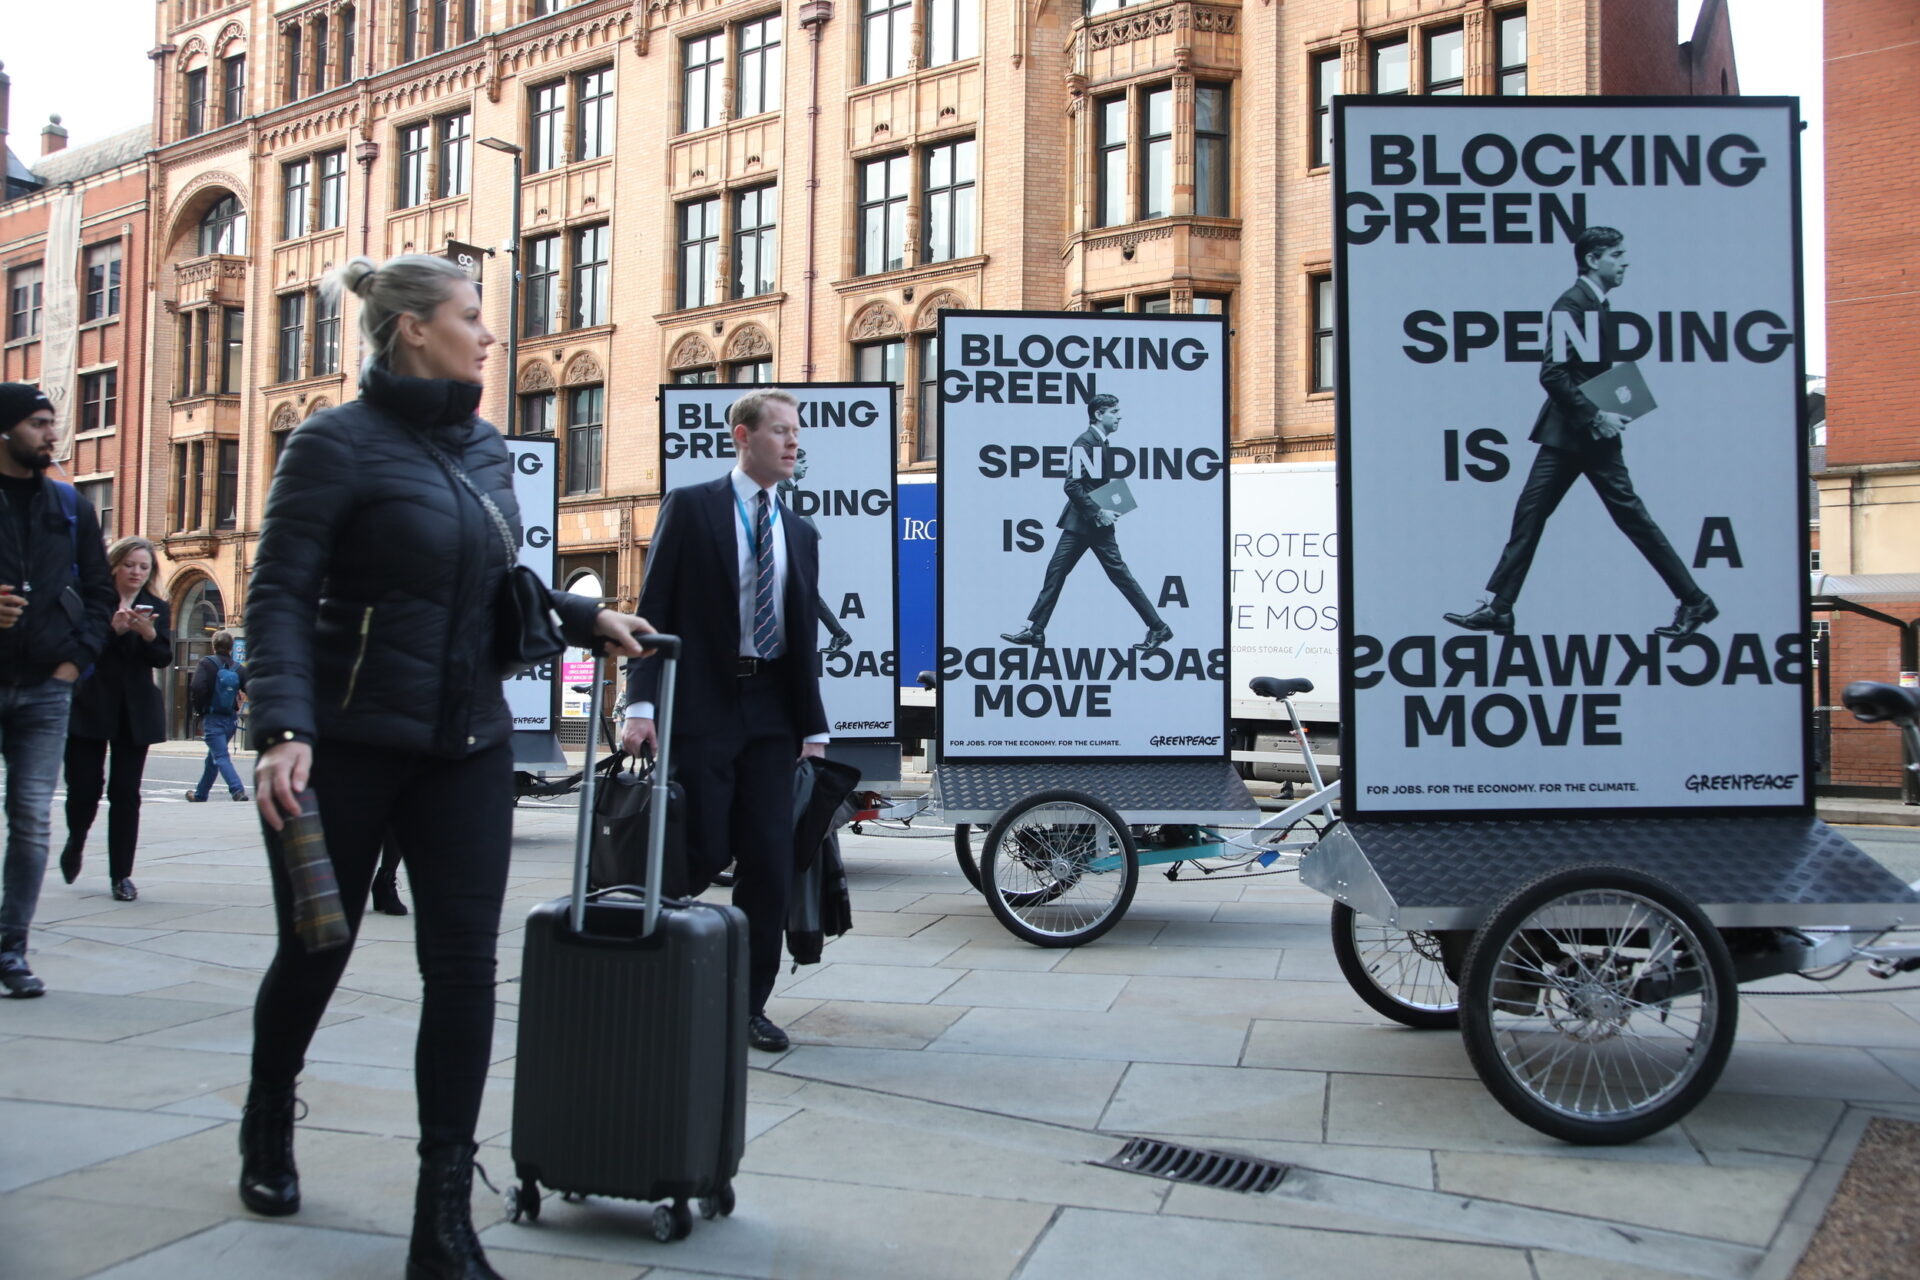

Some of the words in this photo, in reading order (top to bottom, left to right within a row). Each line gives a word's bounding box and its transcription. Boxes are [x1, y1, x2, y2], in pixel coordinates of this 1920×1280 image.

[1370, 133, 1767, 187] BLOCKING
[1347, 191, 1587, 245] GREEN
[961, 334, 1209, 371] BLOCKING
[1402, 309, 1794, 364] SPENDING
[944, 369, 1097, 405] GREEN
[678, 400, 880, 430] BLKING
[665, 432, 738, 460] GRE
[978, 444, 1224, 481] SPENDING
[1444, 428, 1511, 483] IS
[1002, 518, 1045, 553] IS
[1233, 532, 1339, 558] ROTEC
[1693, 516, 1744, 569] A
[1158, 575, 1190, 609] A
[1254, 568, 1325, 595] YOU
[838, 592, 866, 620] A
[1266, 605, 1338, 632] MOS
[1231, 645, 1257, 655] CORDS
[1258, 645, 1293, 655] STORAGE
[1305, 646, 1333, 656] DIGITAL
[974, 683, 1112, 719] MOVE
[834, 720, 893, 732] GREENPEACE
[1404, 692, 1623, 749] MOVE
[1149, 735, 1221, 748] GREENPEACE
[1366, 786, 1390, 795] FOR
[1392, 785, 1425, 795] JOBS.
[1427, 785, 1450, 794] FOR
[1452, 784, 1475, 794] THE
[1477, 784, 1537, 794] ECONOMY.
[1539, 784, 1562, 793] FOR
[1564, 783, 1586, 793] THE
[1588, 782, 1639, 792] CLIMATE.
[1685, 773, 1800, 793] GREENPEACE
